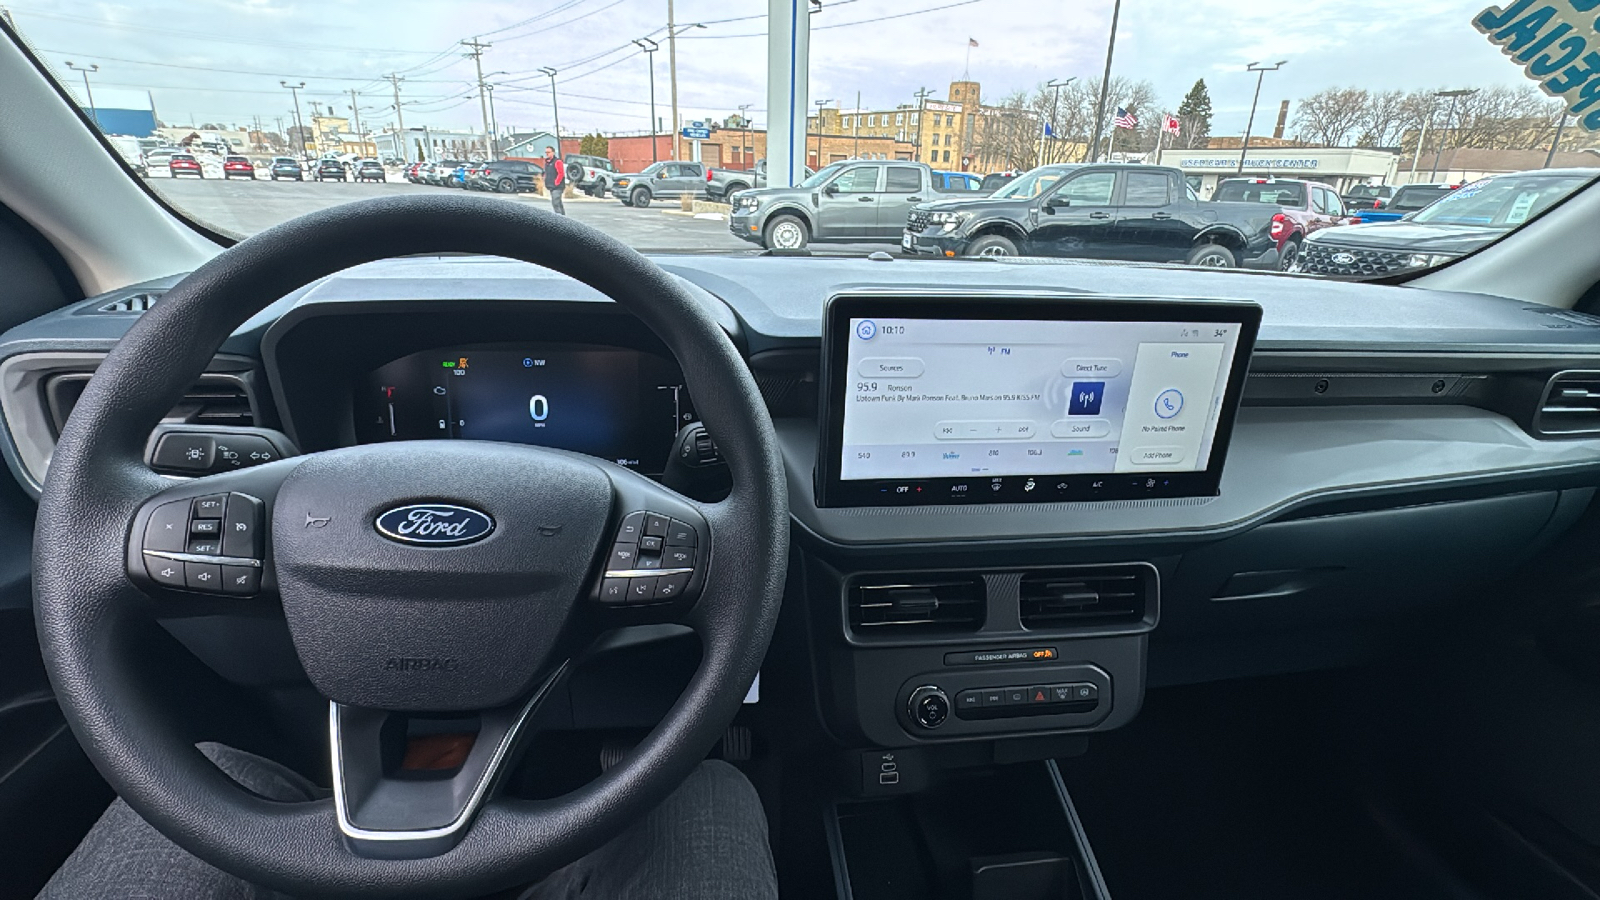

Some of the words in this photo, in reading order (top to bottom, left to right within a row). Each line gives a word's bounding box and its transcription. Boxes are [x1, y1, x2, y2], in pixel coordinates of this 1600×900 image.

[1275, 160, 1318, 168] CENTER
[882, 325, 905, 335] 10:10
[1000, 347, 1011, 355] FM
[879, 364, 904, 372] Sources
[1076, 364, 1093, 372] Direct
[1094, 364, 1108, 372] Tune
[857, 382, 878, 392] 95.9
[887, 384, 913, 392] Ronson
[856, 394, 881, 402] Uptown
[881, 394, 896, 402] Funk
[897, 394, 905, 402] By
[906, 394, 921, 402] Mark
[921, 394, 944, 402] Ronson
[529, 394, 549, 421] 0
[1071, 425, 1091, 433] Sound
[398, 509, 470, 538] Ford
[974, 653, 1007, 661] PASSENGER
[1033, 650, 1044, 658] OFF
